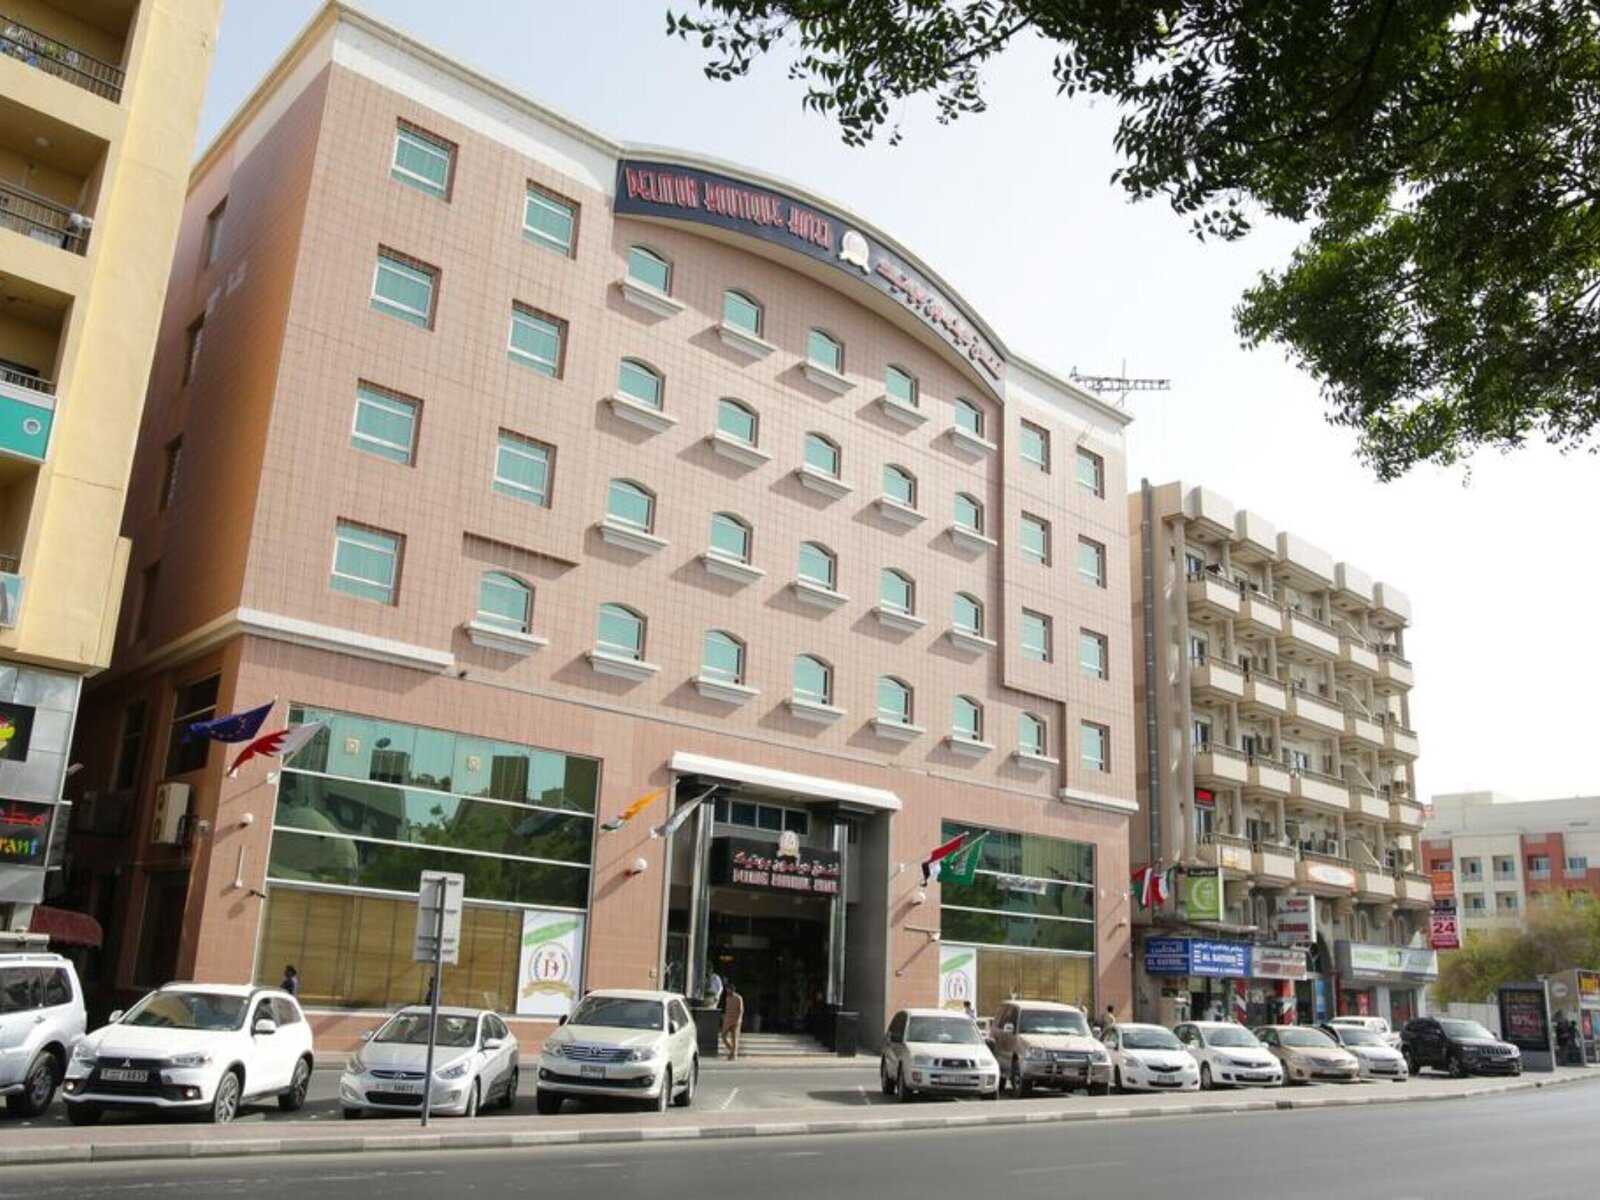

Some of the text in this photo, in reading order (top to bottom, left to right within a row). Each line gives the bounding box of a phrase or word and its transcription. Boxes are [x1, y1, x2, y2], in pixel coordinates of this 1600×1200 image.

[625, 167, 829, 248] DELMON BOUTIQUE HOTEL
[1432, 922, 1456, 934] 24
